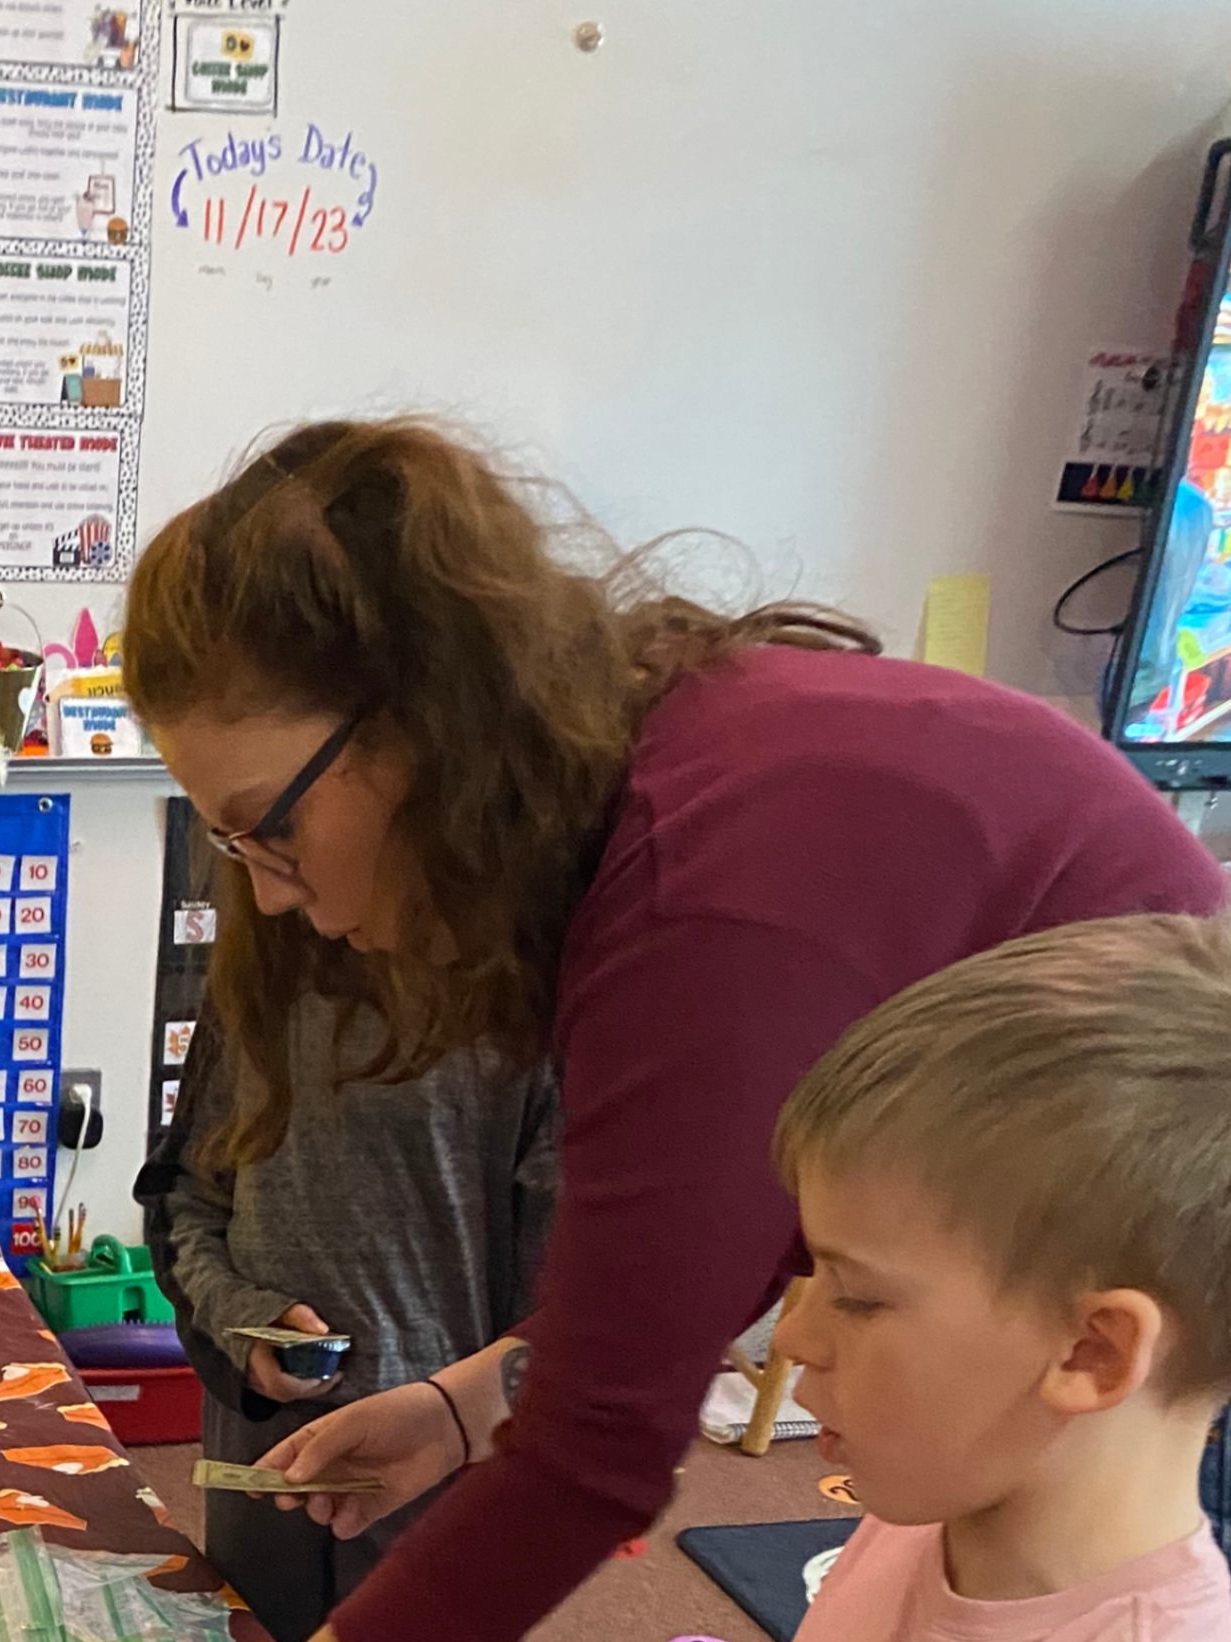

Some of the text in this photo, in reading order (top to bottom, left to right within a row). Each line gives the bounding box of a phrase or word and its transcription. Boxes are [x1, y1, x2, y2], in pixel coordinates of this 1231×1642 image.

[178, 123, 366, 182] Todays Date
[204, 184, 348, 256] 11/17/23
[27, 864, 50, 880] 10
[19, 907, 45, 925] 20
[26, 952, 50, 971] 30
[19, 994, 44, 1012] 40
[17, 1036, 42, 1051] 50
[21, 1077, 47, 1094] 60
[19, 1119, 41, 1133] 70
[18, 1156, 42, 1170] 80
[13, 1230, 41, 1247] 100
